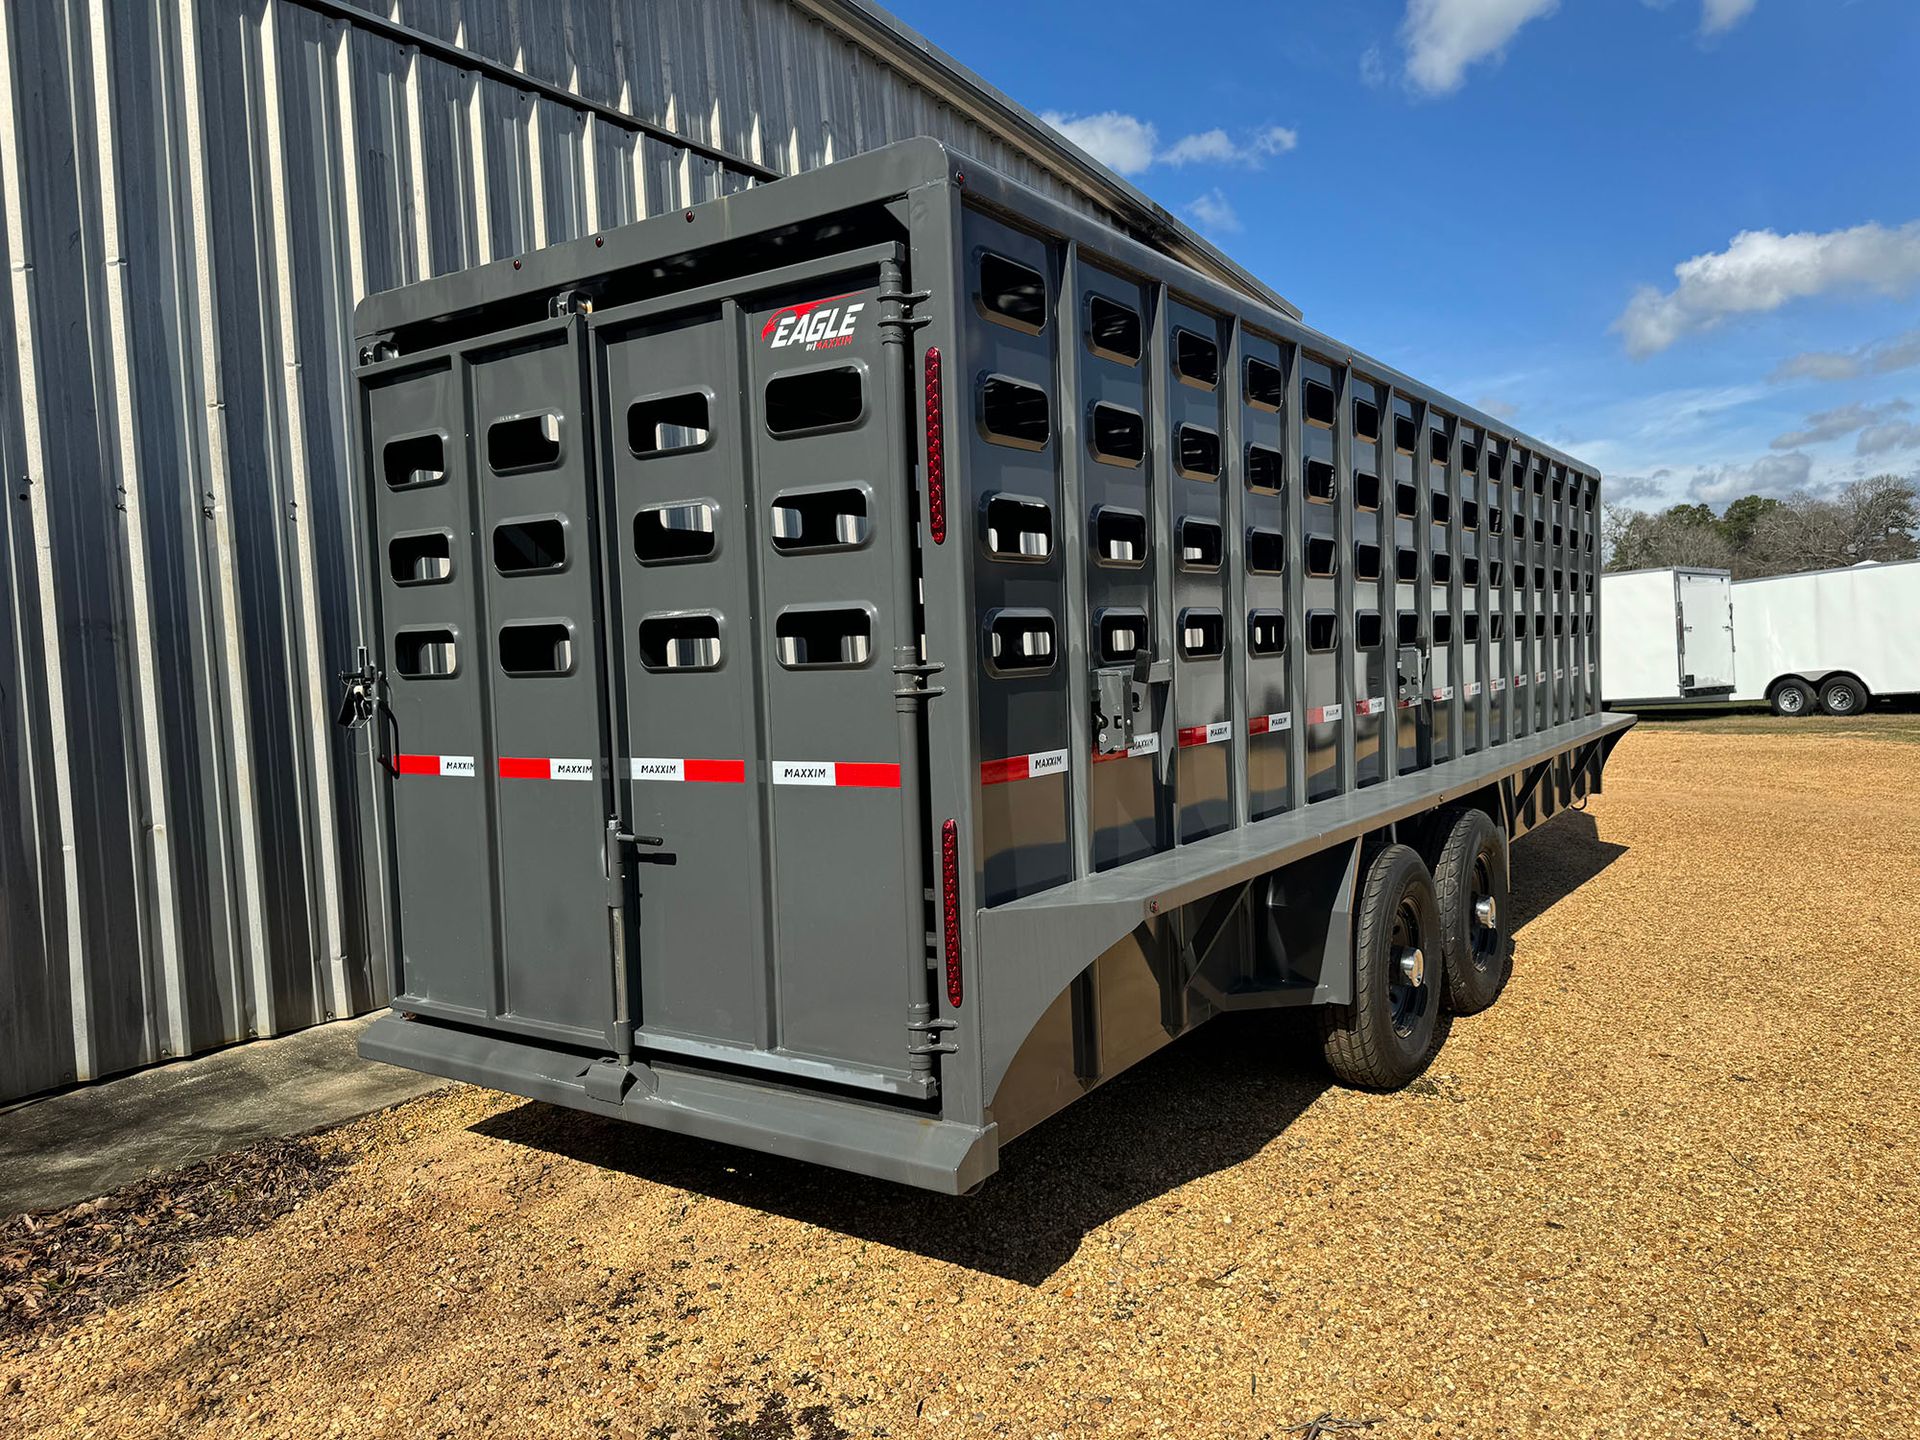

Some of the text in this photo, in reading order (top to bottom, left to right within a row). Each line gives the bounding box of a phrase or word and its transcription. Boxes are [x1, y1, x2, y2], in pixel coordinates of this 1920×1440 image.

[771, 303, 865, 348] EAGLE
[813, 335, 853, 350] MAXXIM
[1034, 755, 1063, 770] MAXXIM
[557, 764, 593, 774] MAXXIM
[640, 765, 677, 774] MAXXIM
[783, 768, 827, 778] MAXXIM
